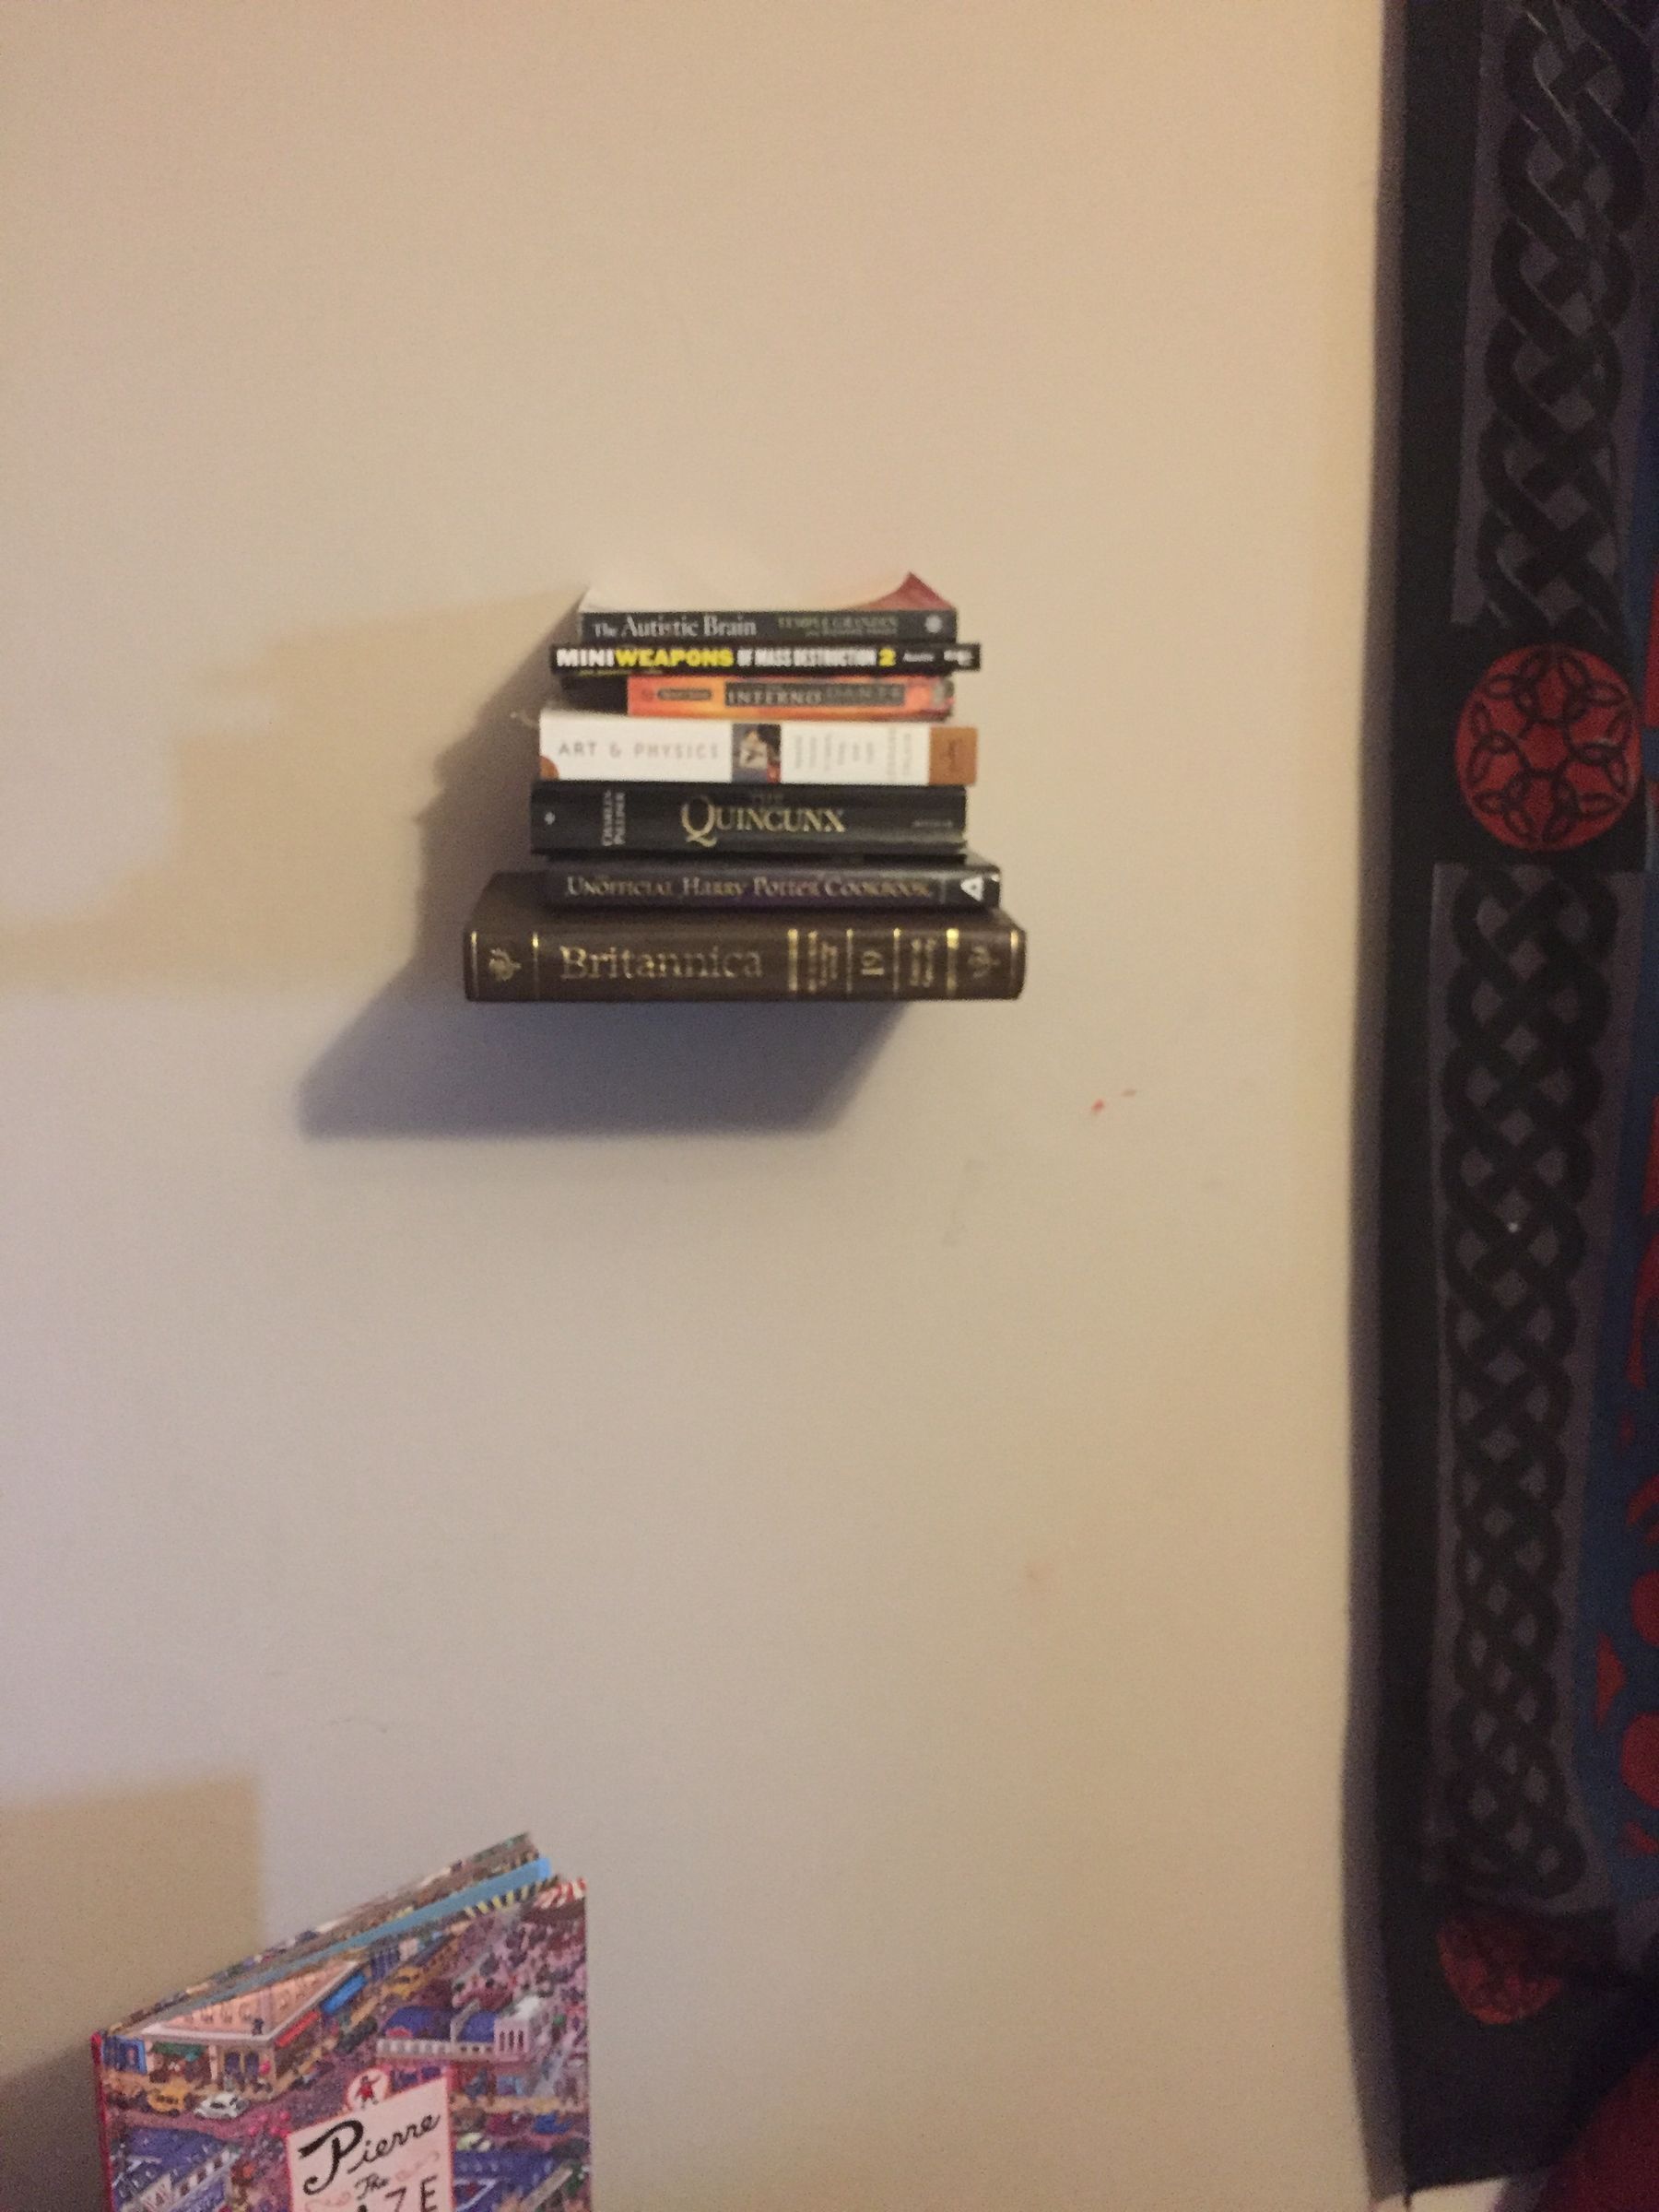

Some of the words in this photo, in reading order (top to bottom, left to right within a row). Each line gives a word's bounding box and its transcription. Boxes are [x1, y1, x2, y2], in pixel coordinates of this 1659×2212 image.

[594, 621, 617, 638] The
[621, 615, 698, 638] Autistic
[703, 615, 757, 637] Brain
[736, 648, 753, 666] OF
[755, 648, 792, 666] MASS
[794, 648, 877, 667] DESTRUCTION
[878, 647, 897, 667] 2
[727, 690, 822, 705] INFERNO
[559, 741, 597, 757] ART
[609, 742, 622, 759] &
[634, 742, 719, 759] PHYSICS
[681, 795, 846, 848] QUINCUNX
[559, 945, 764, 980] Britannica
[298, 2113, 441, 2195] Pierre
[354, 2172, 389, 2201] The
